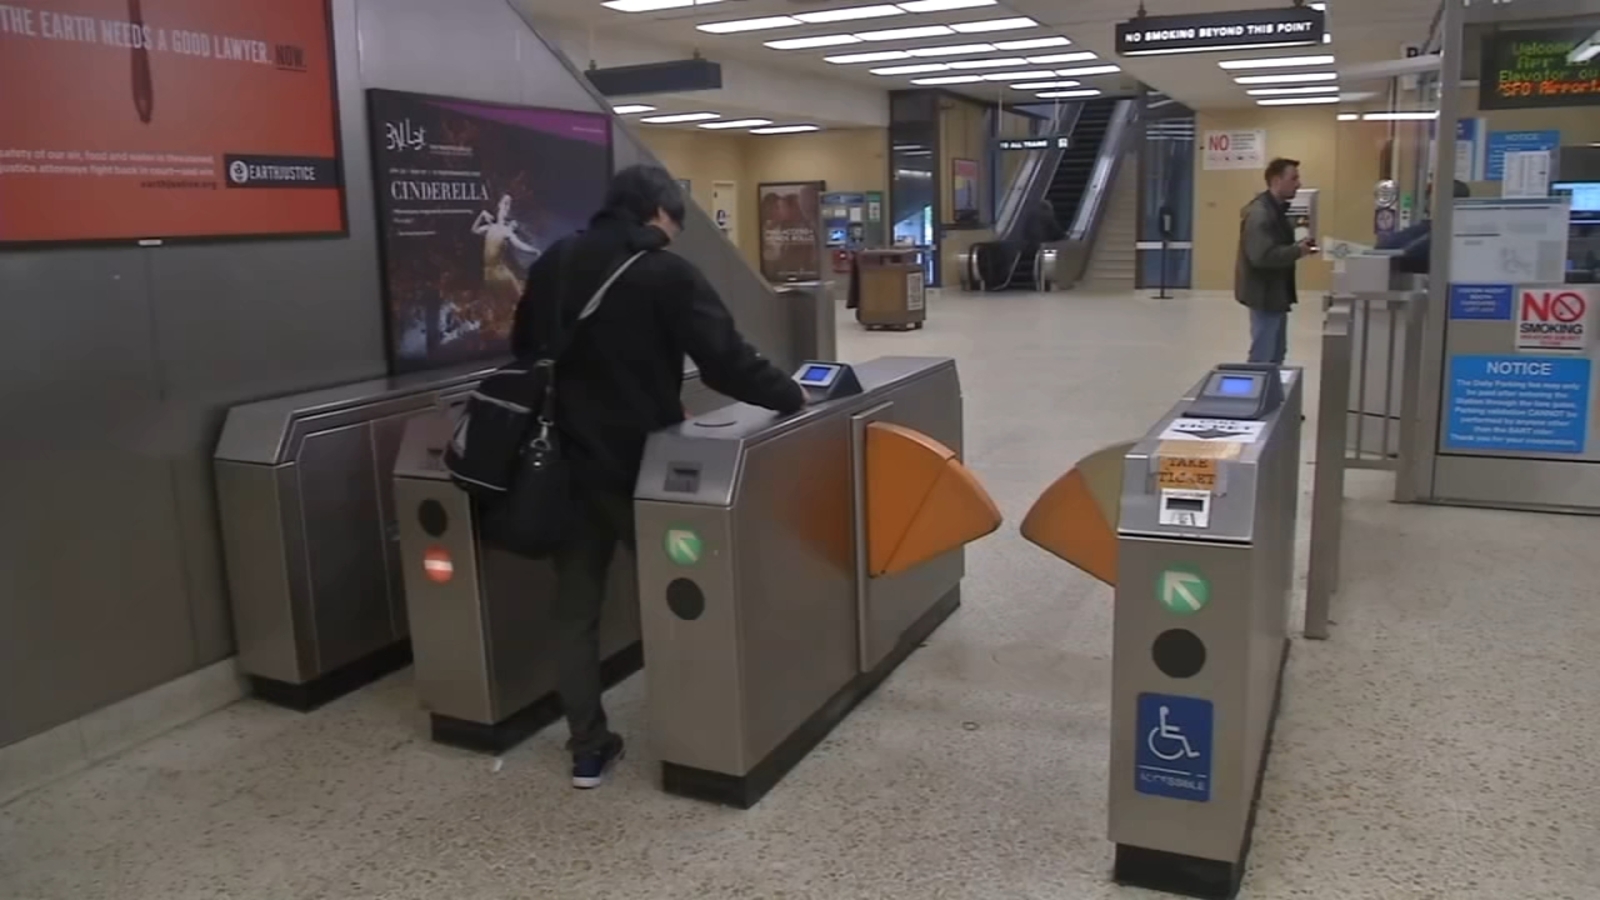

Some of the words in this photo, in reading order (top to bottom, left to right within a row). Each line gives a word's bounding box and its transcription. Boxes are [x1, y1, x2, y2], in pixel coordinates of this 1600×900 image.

[0, 5, 36, 36] THE
[39, 11, 96, 43] EARTH
[100, 20, 152, 50] NEEDS
[157, 30, 168, 51] A
[172, 30, 210, 57] GOOD
[214, 36, 273, 65] LAWYER.
[1125, 32, 1141, 42] NO
[1145, 29, 1195, 41] SMOKING
[1199, 26, 1243, 37] BEYOND
[1247, 24, 1273, 35] THIS
[1277, 22, 1312, 33] POINT
[1499, 70, 1568, 82] Elevator
[1209, 134, 1230, 151] NO
[249, 165, 316, 180] EARTHJUSTICE
[390, 180, 489, 201] CINDERELLA
[1520, 323, 1583, 335] SMOKING
[1486, 361, 1553, 375] NOTICE
[1167, 457, 1208, 469] TAKE
